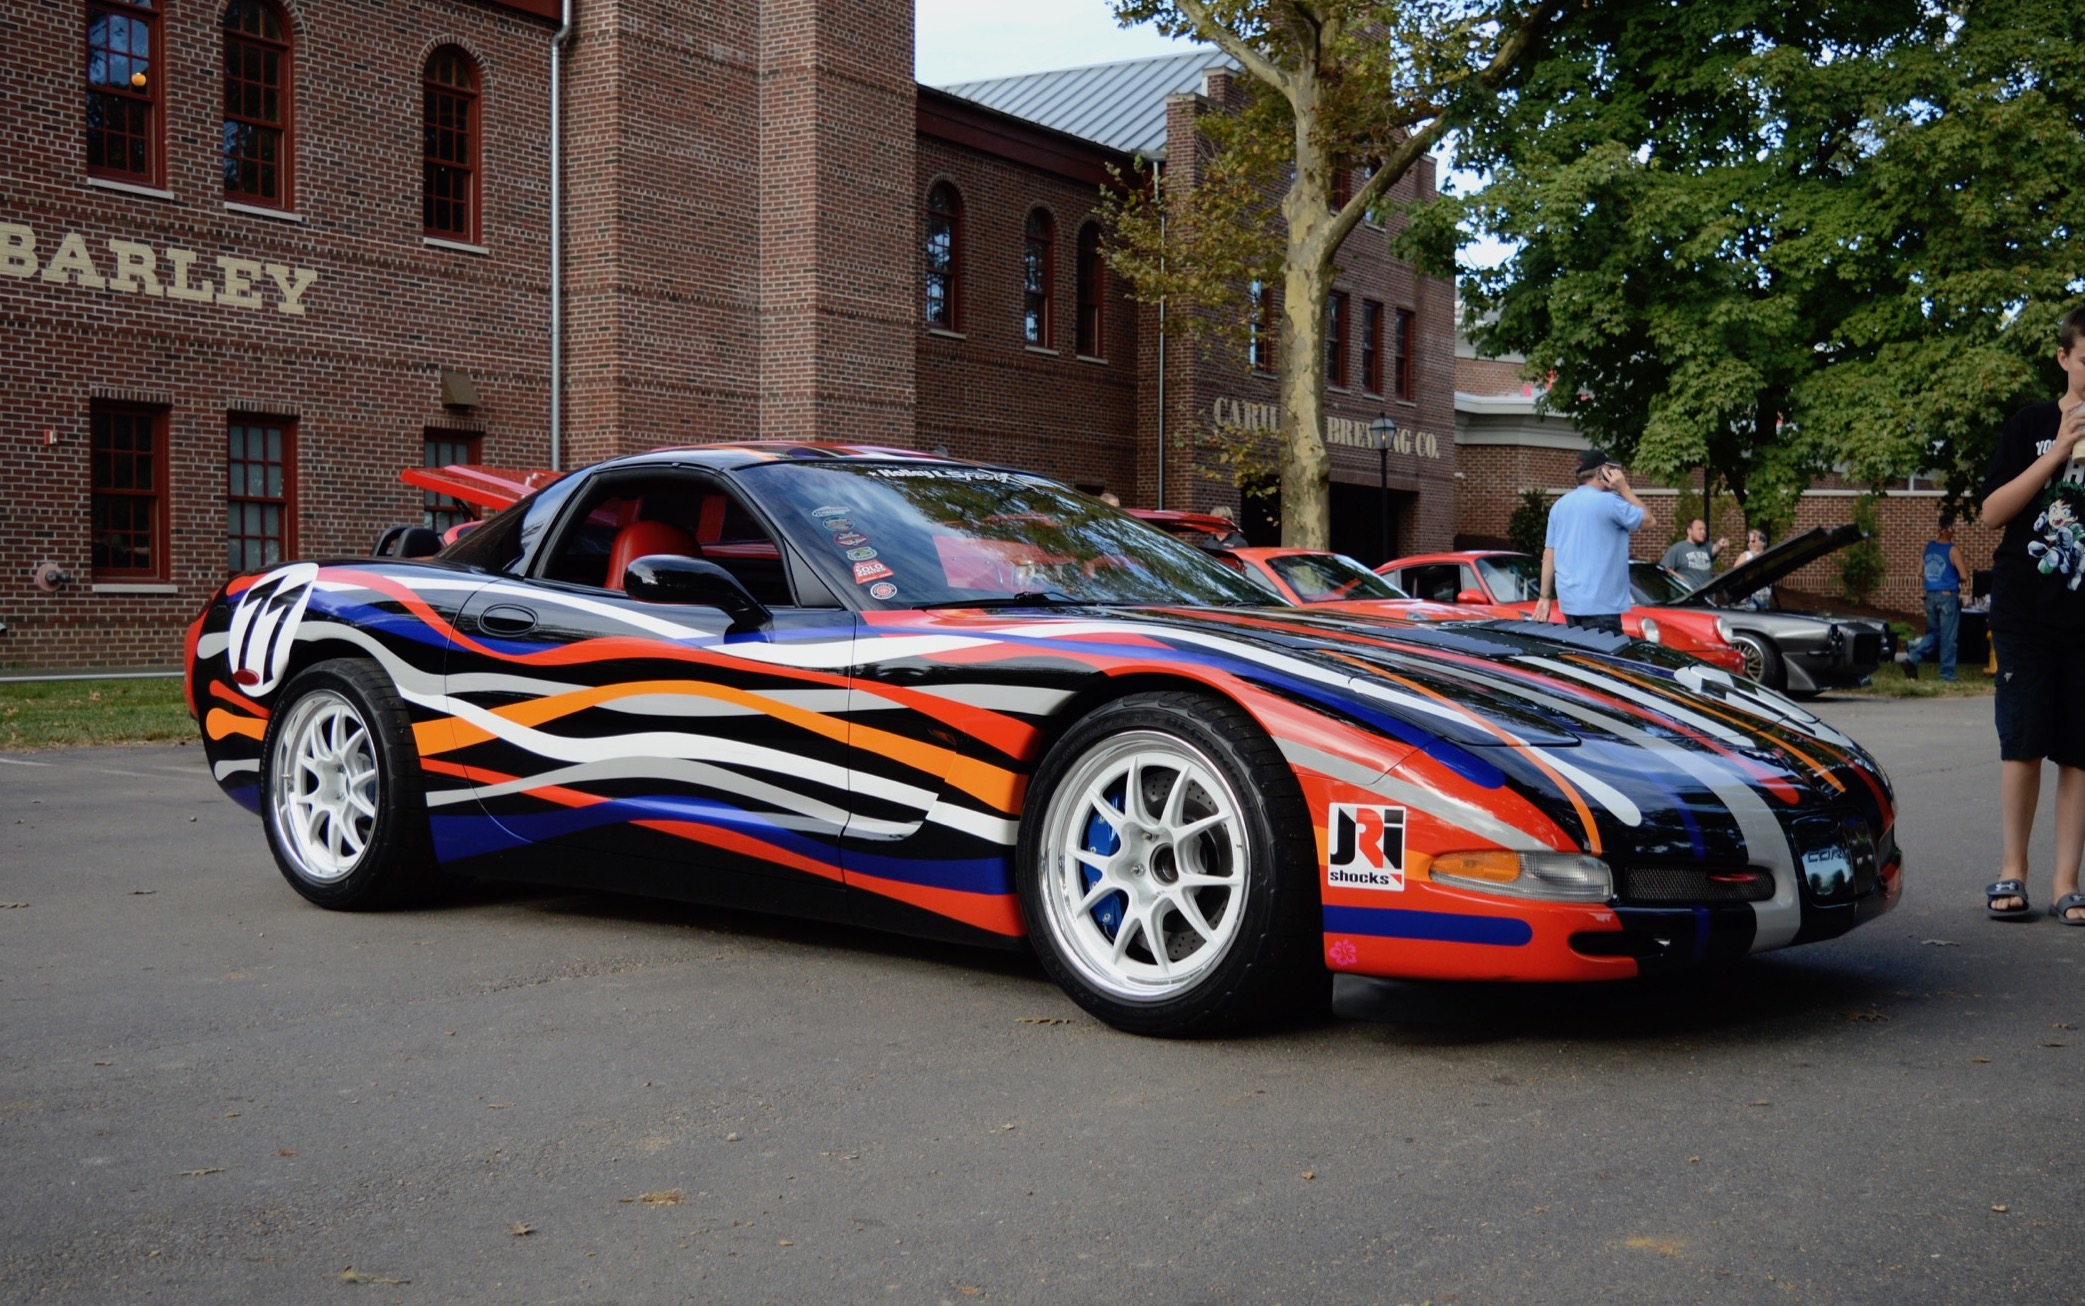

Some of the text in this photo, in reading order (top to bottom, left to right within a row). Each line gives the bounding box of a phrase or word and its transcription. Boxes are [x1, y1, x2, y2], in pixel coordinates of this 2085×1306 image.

[0, 221, 318, 316] BARLEY
[1415, 431, 1441, 459] CO.
[1330, 870, 1389, 884] shocks
